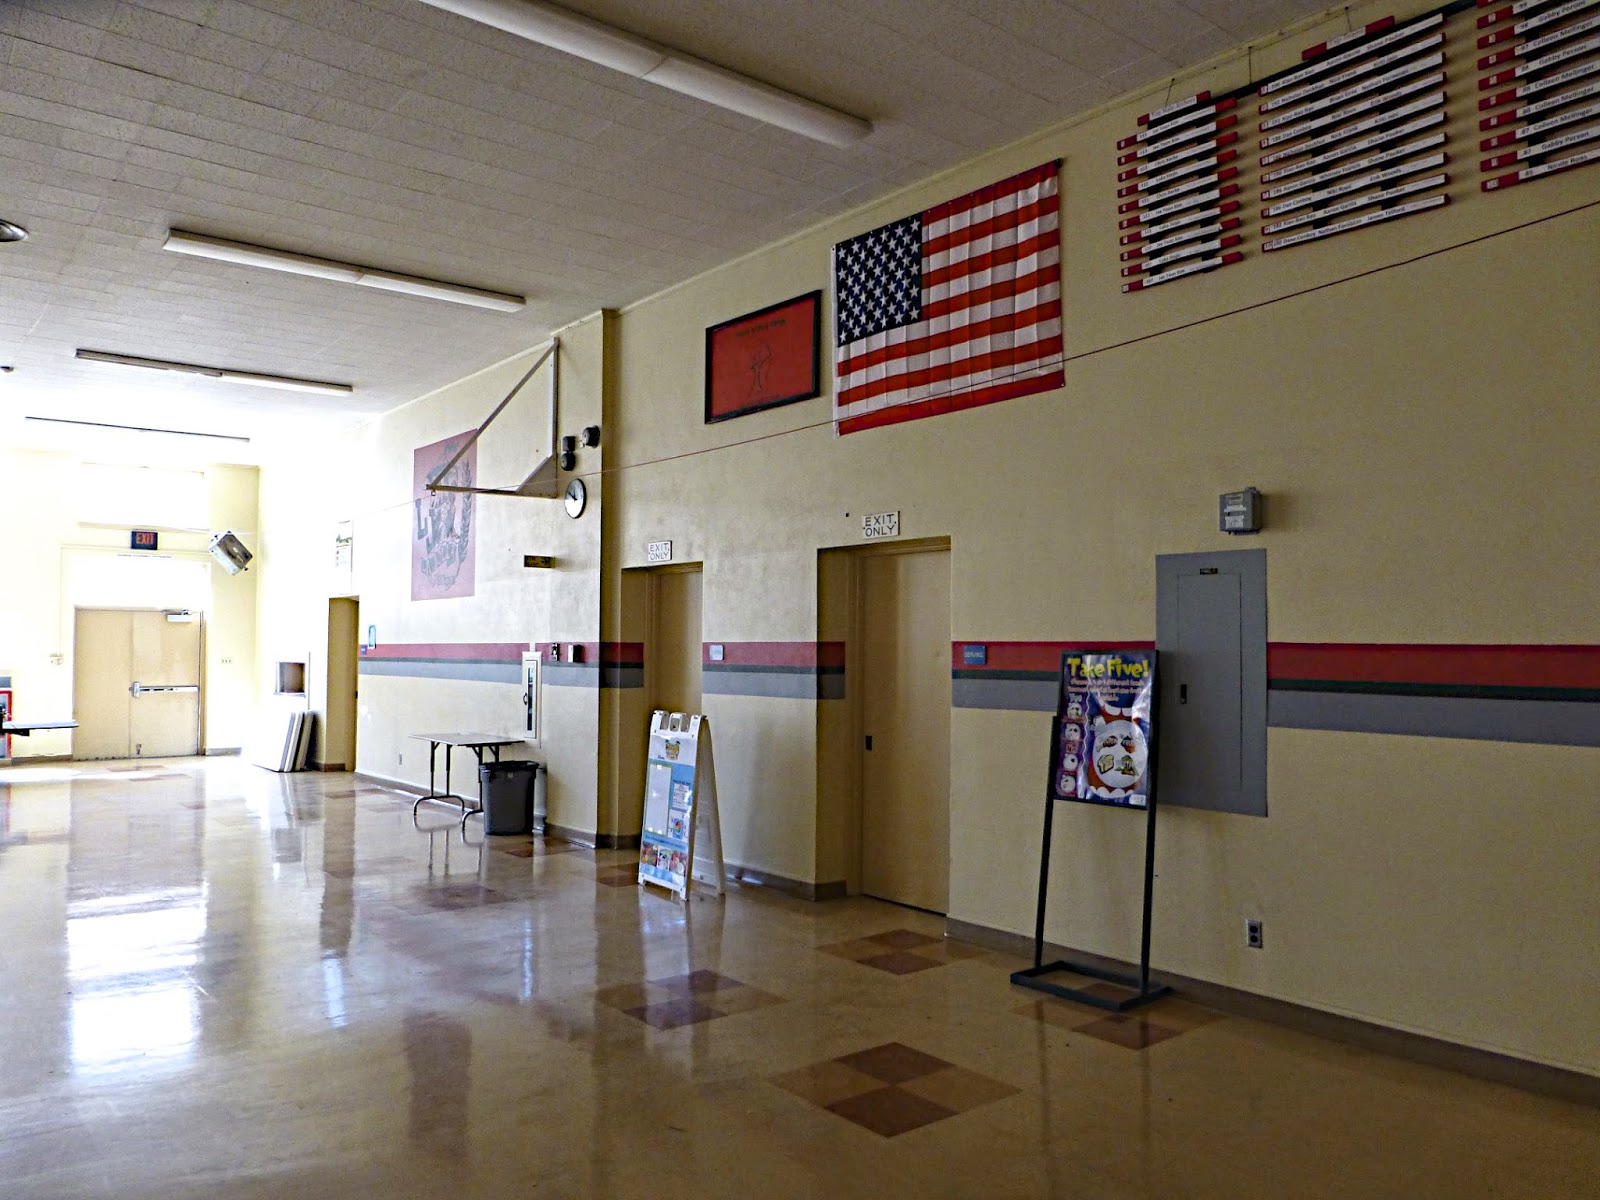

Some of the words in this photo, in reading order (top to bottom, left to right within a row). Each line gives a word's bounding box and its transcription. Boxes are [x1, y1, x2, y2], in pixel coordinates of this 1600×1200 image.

[865, 513, 894, 526] EXIT
[865, 524, 895, 537] ONLY
[136, 532, 155, 545] EXIT
[649, 543, 669, 552] EXIT
[649, 551, 669, 561] ONLY
[1067, 657, 1105, 678] Take
[1107, 657, 1150, 678] Five!
